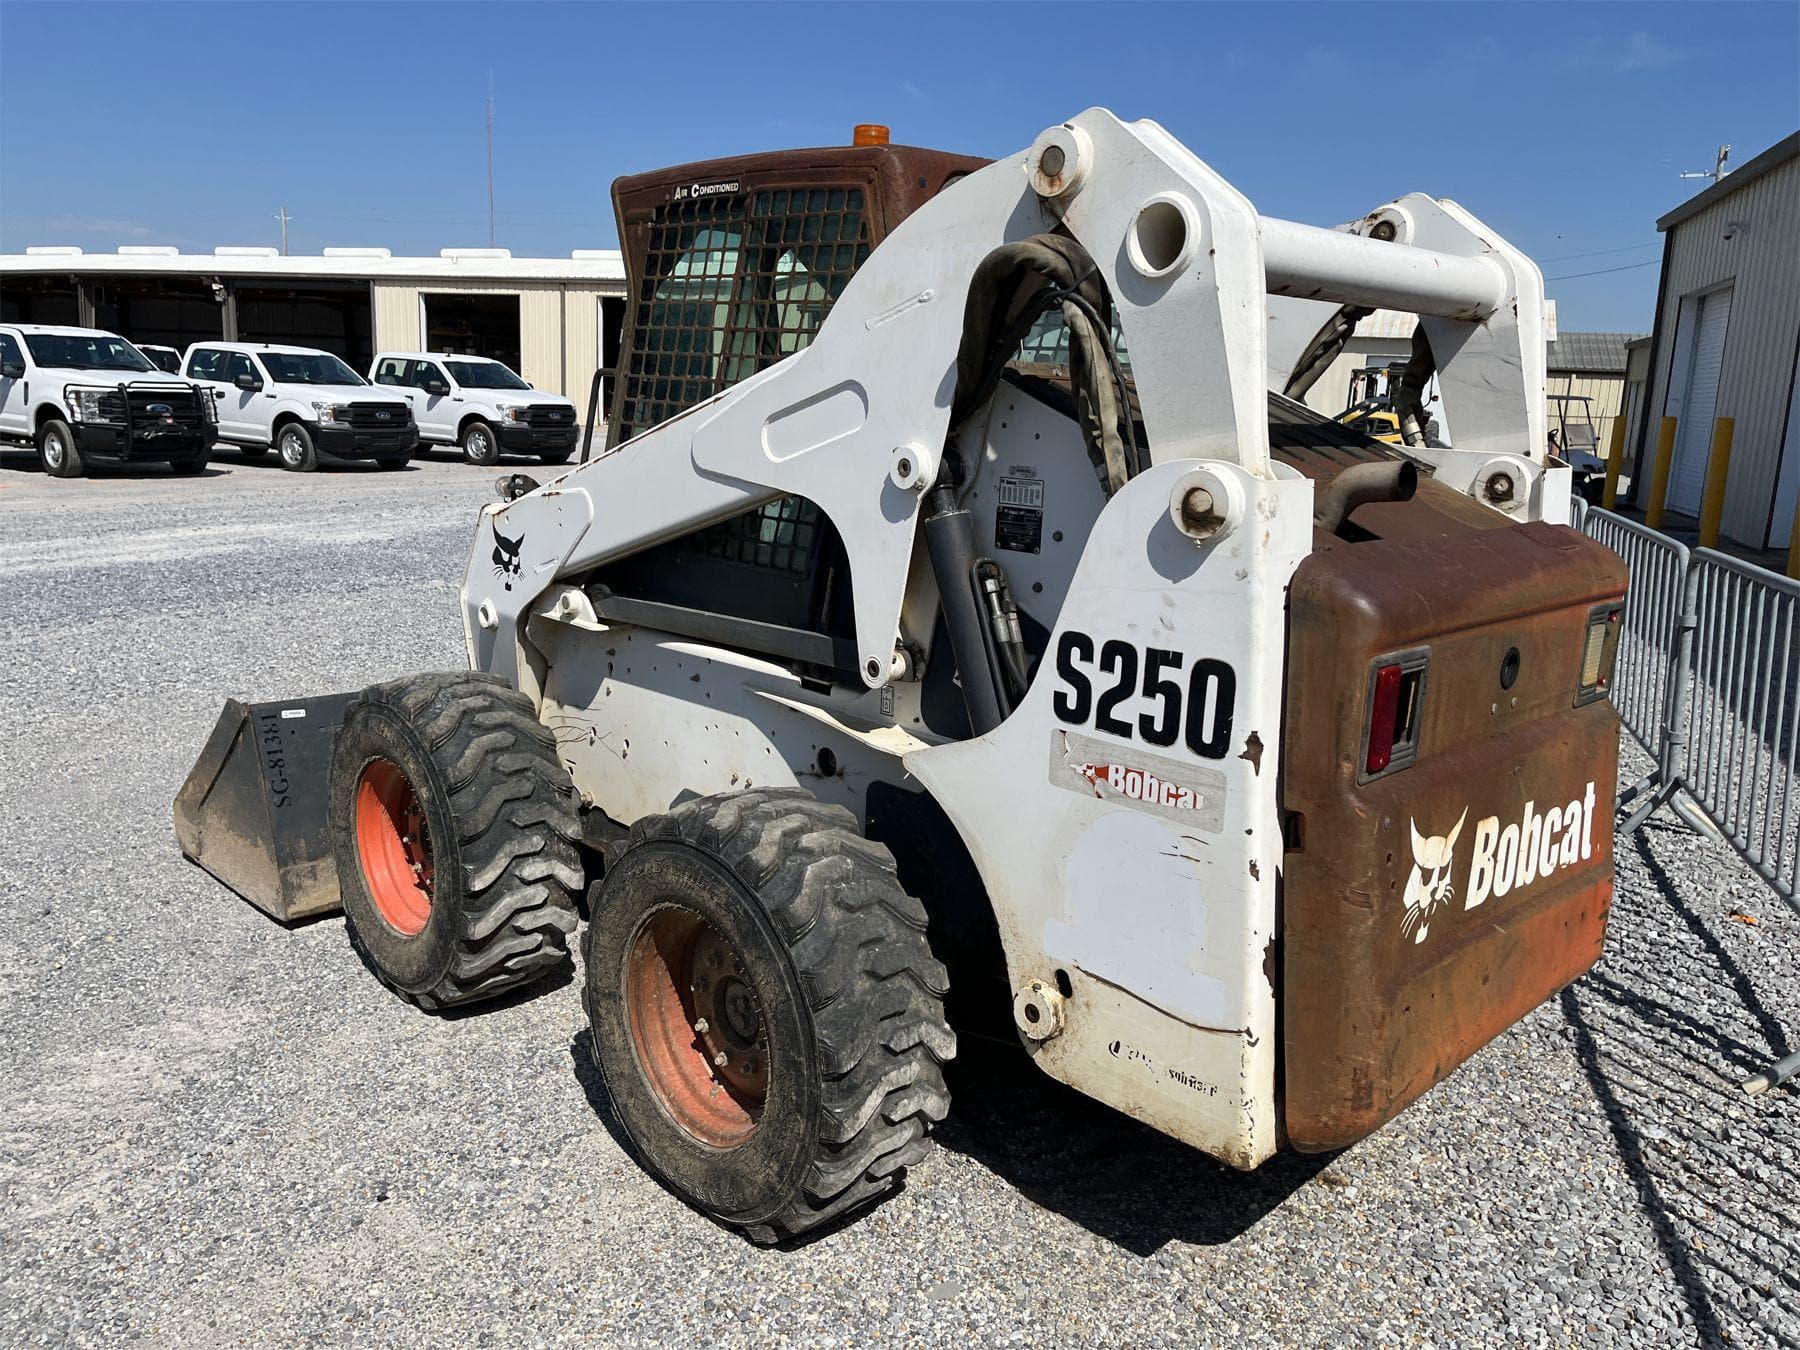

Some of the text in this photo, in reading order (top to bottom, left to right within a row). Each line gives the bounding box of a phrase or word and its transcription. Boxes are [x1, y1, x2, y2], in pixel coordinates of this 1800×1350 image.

[1053, 630, 1236, 760] S250
[261, 713, 292, 808] SG-81381
[1465, 781, 1596, 911] Bobcat
